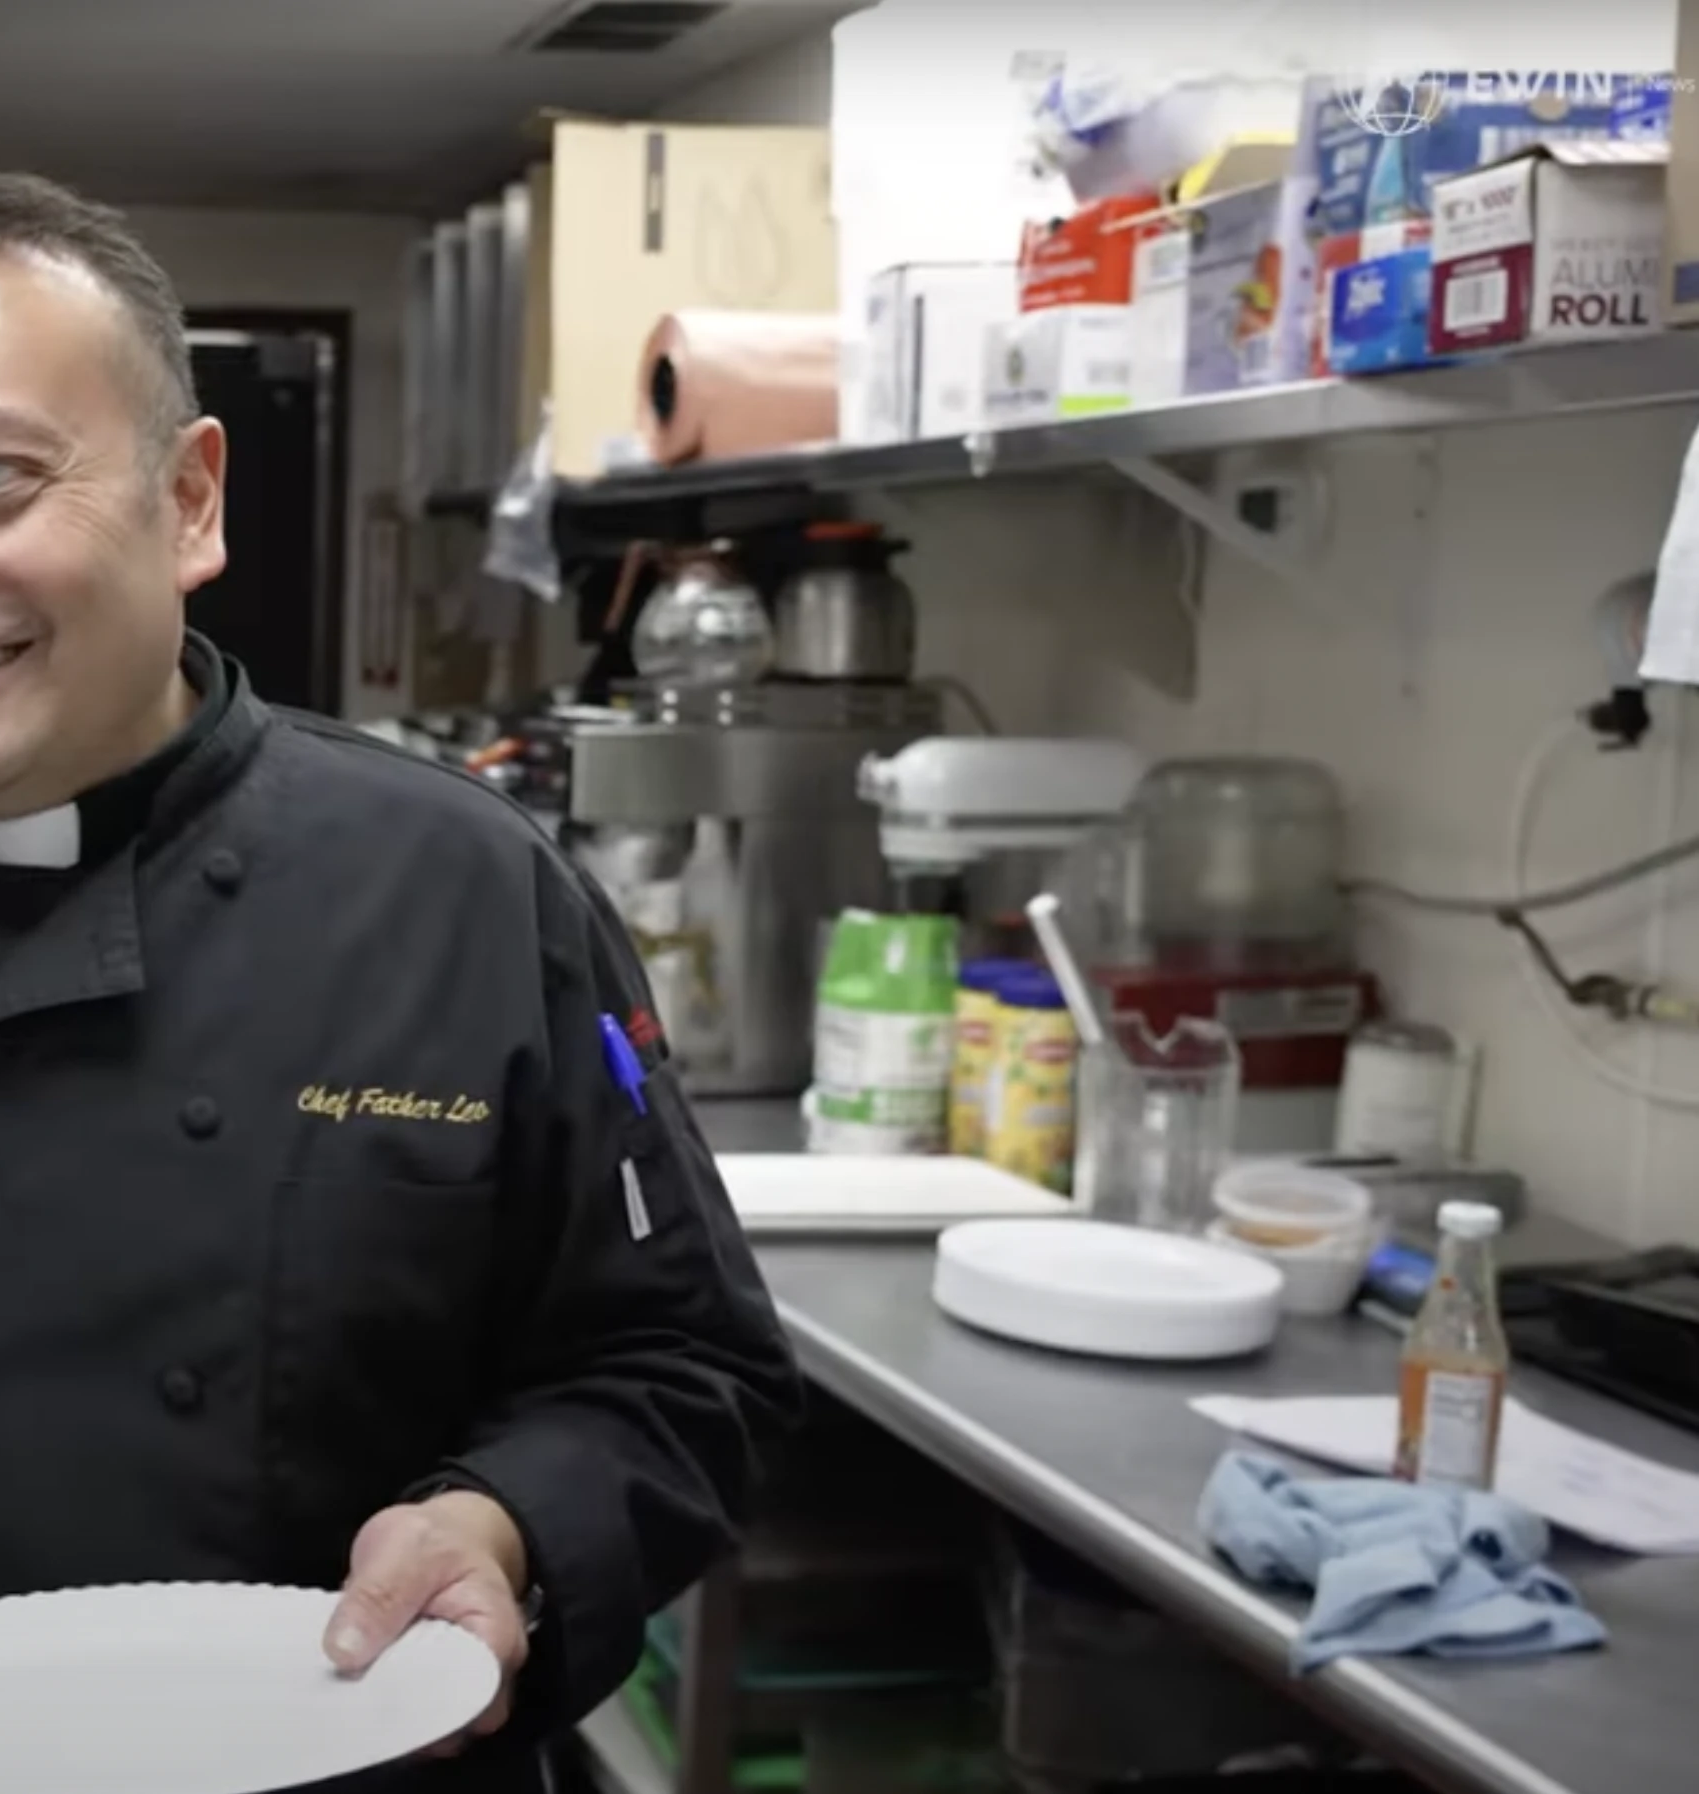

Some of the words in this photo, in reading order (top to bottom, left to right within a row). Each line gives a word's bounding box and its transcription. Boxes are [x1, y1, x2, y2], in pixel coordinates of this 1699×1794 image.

[1548, 291, 1649, 327] ROLL
[297, 1084, 352, 1122] Chef
[356, 1087, 443, 1121] Father
[444, 1094, 491, 1122] Leo
